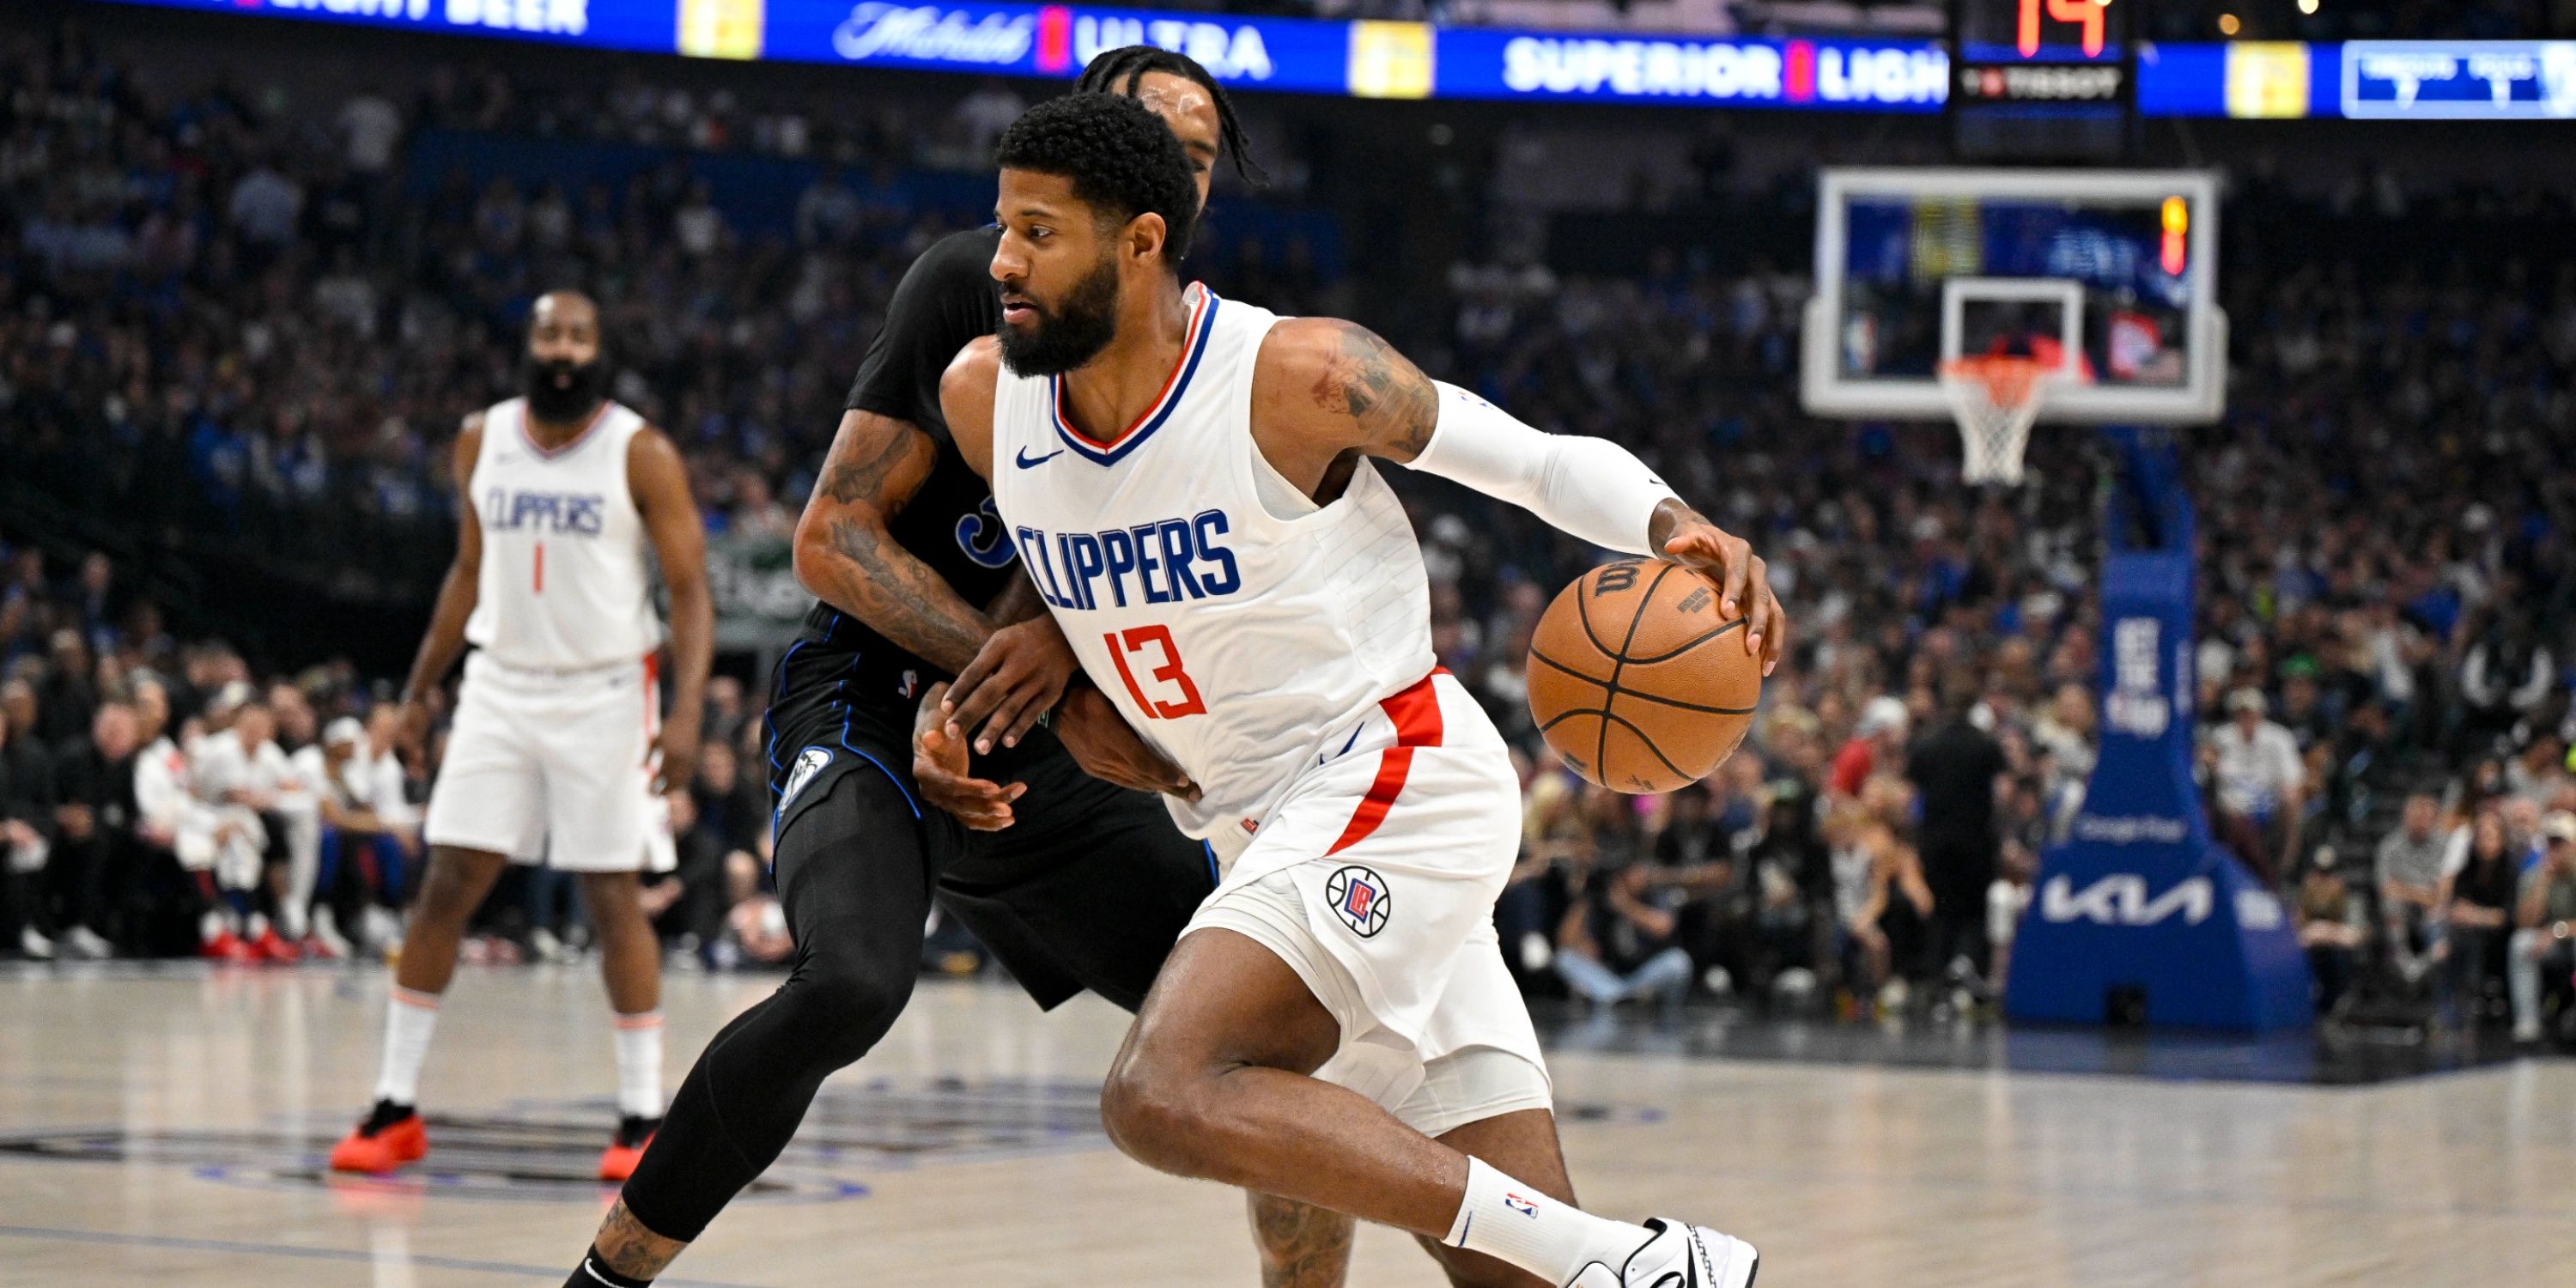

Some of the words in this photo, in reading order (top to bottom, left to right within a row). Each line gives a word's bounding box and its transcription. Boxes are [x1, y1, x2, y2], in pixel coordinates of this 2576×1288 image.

[1504, 37, 1782, 98] SUPERIOR
[487, 488, 605, 536] CLIPPERS
[532, 543, 544, 594] 1
[1016, 508, 1242, 610] CLIPPERS
[1103, 624, 1207, 719] 13
